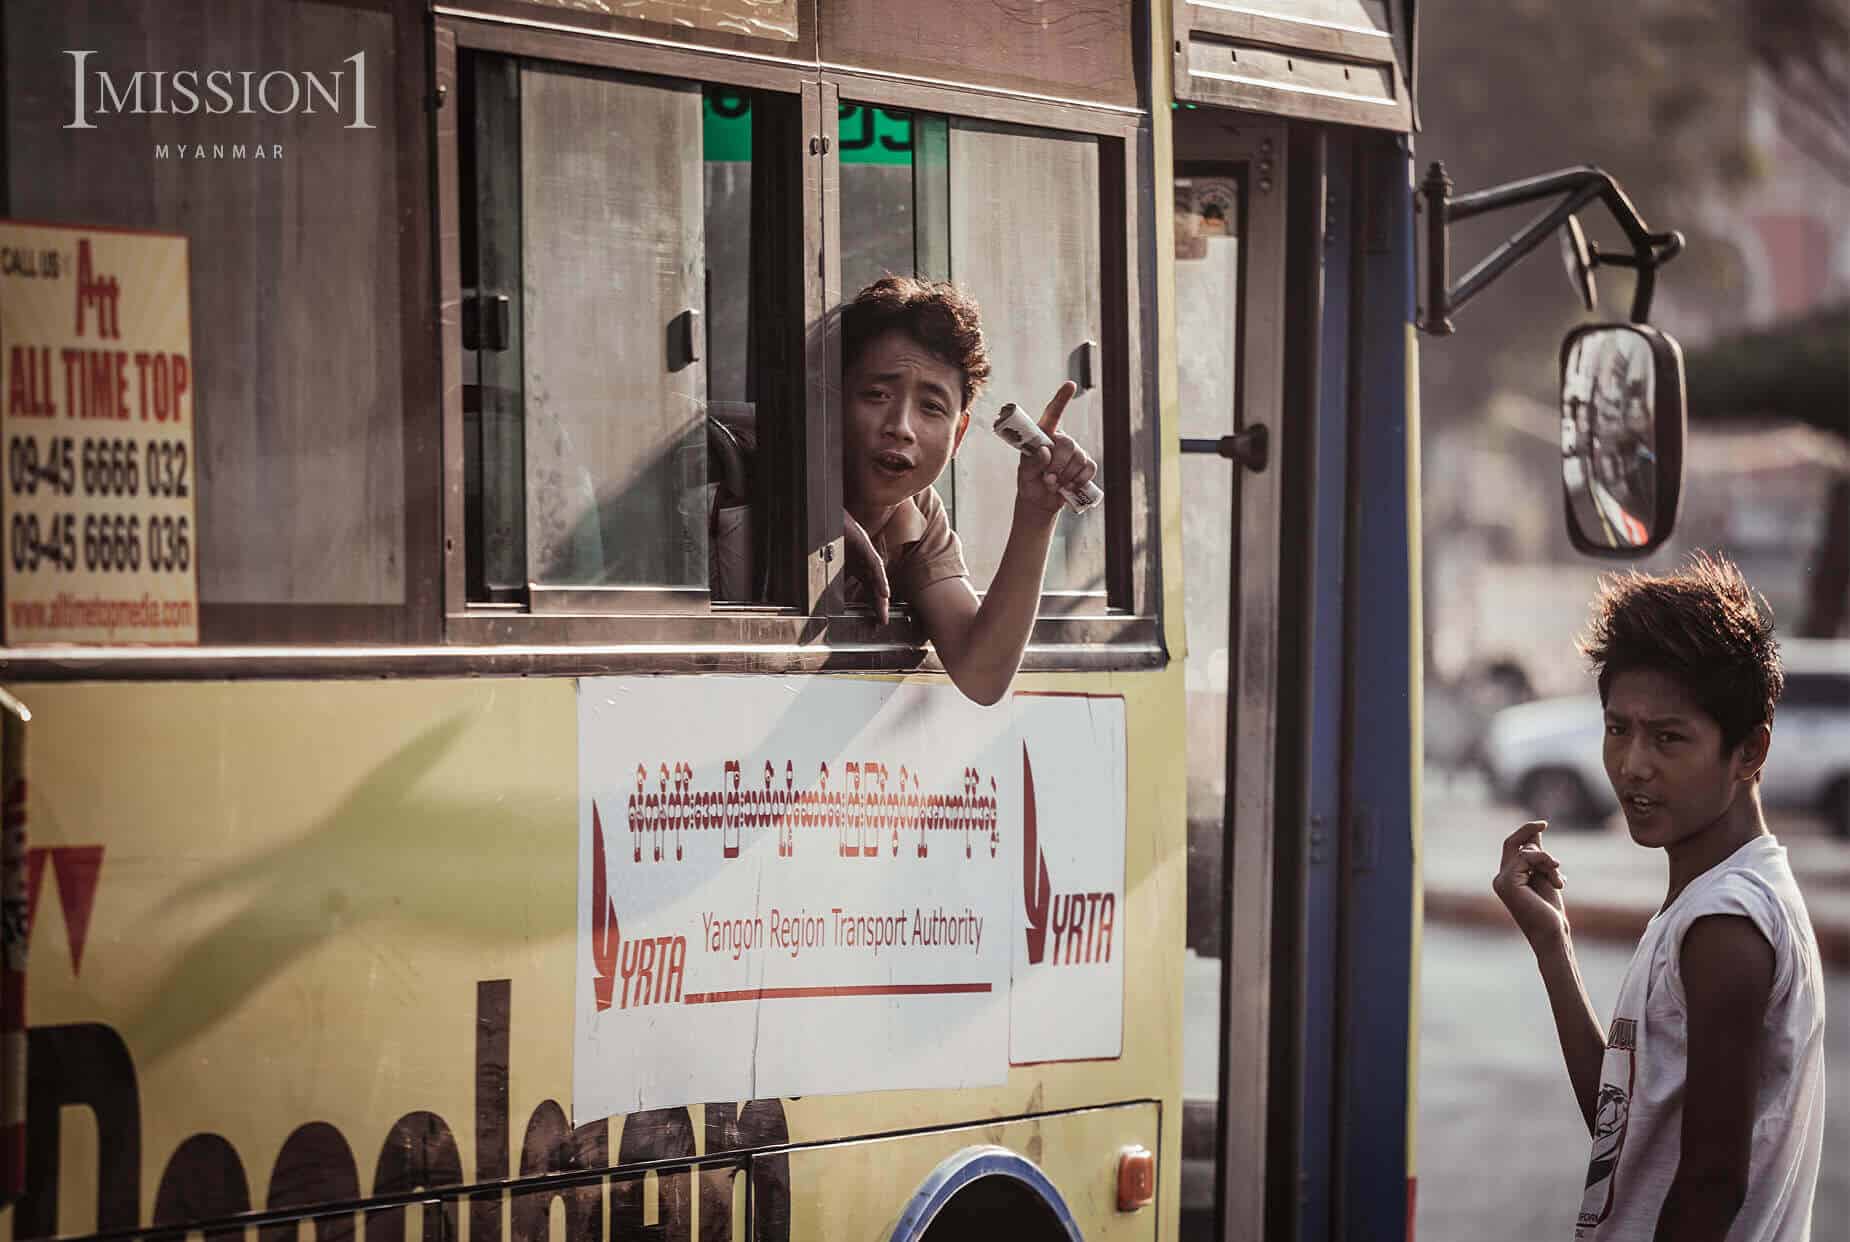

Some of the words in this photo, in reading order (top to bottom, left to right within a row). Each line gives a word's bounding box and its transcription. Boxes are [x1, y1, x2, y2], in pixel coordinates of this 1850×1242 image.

[9, 344, 56, 417] ALL
[61, 347, 130, 421] TIME
[134, 352, 188, 423] TOP
[81, 437, 140, 497] 6666
[147, 440, 188, 498] 032
[83, 513, 141, 574] 6666
[149, 514, 190, 574] 036
[702, 911, 763, 961] Yangon
[770, 907, 825, 958] Region
[831, 908, 908, 955] Transport
[912, 907, 984, 955] Authority
[1051, 892, 1115, 967] YRTA
[620, 935, 687, 1010] YRTA
